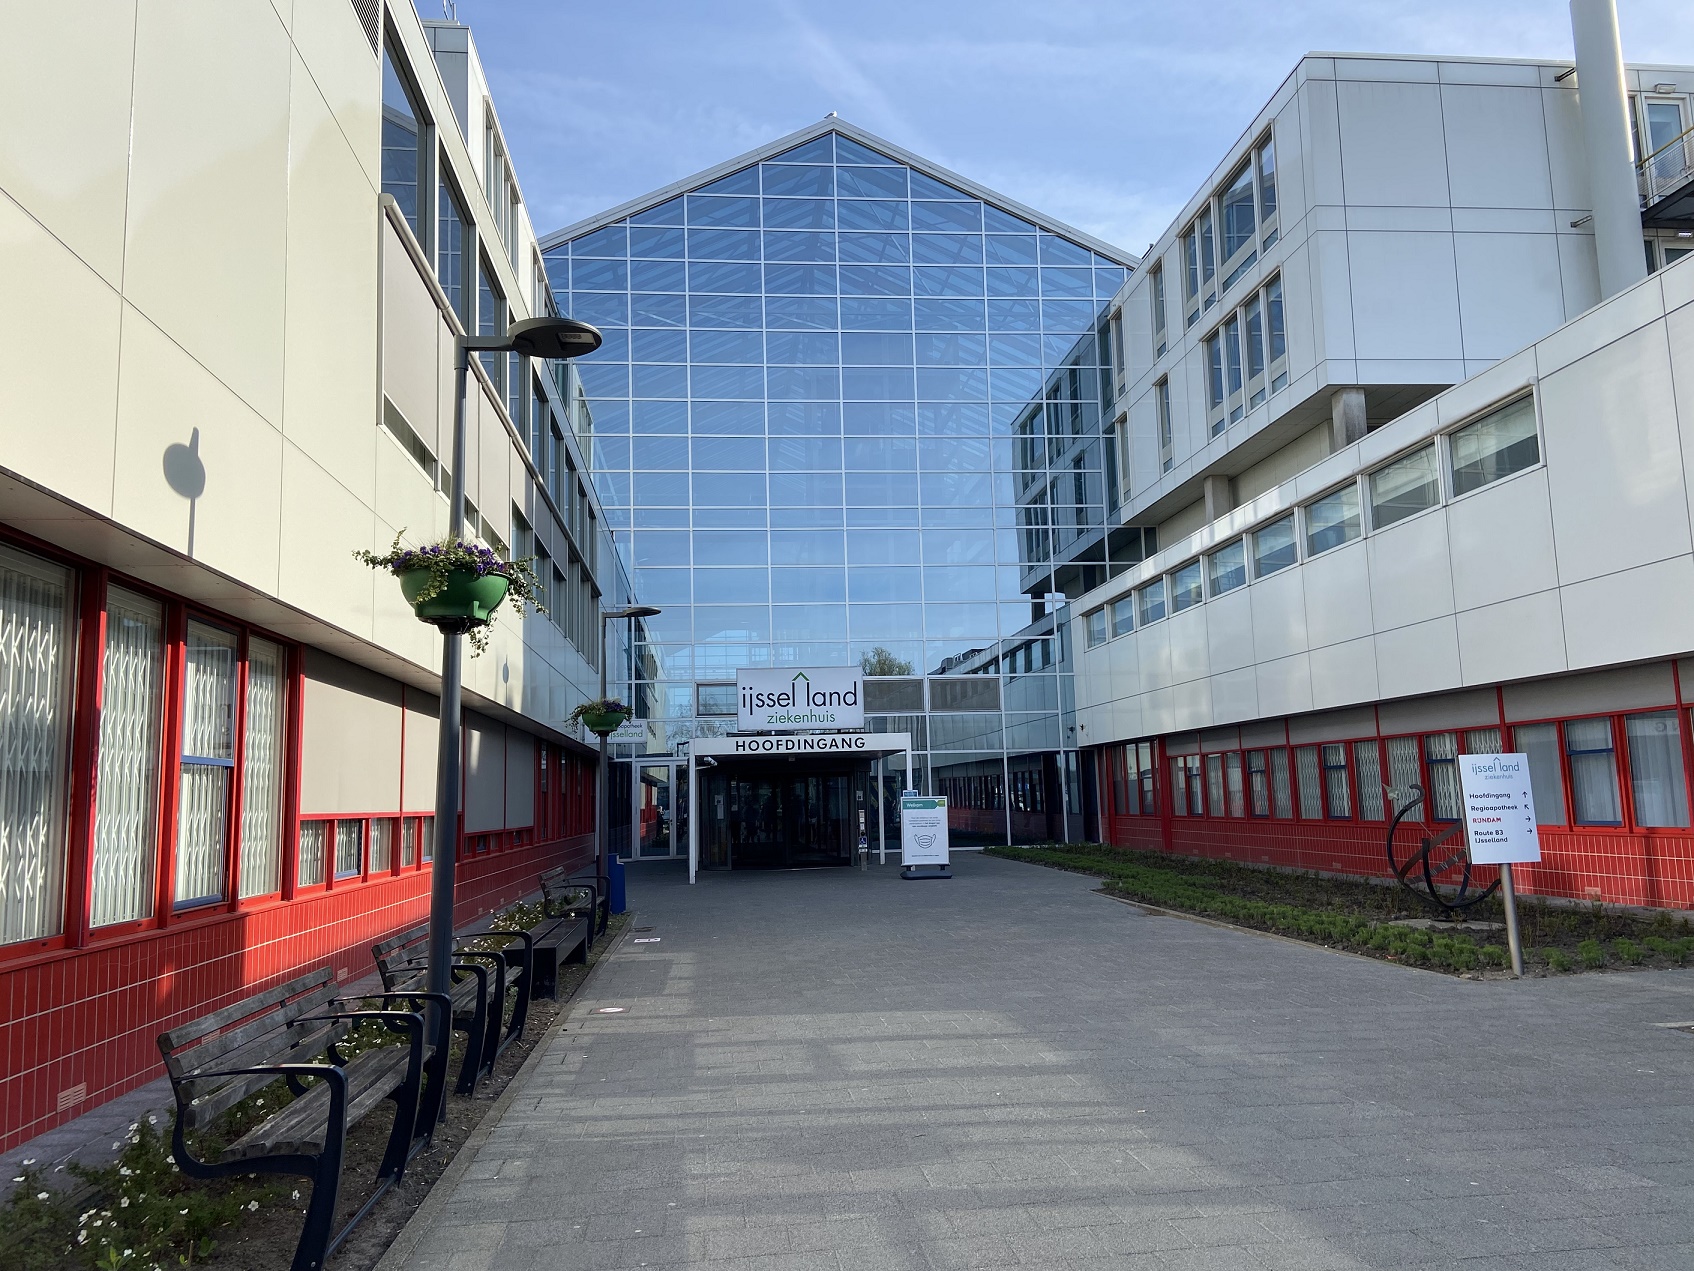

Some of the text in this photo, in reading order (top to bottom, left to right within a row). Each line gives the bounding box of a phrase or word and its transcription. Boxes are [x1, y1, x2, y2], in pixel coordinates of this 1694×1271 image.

[766, 709, 836, 725] ziekenhuis
[735, 737, 866, 752] HOOFDINGANG
[1470, 804, 1519, 812] Regioapotheek
